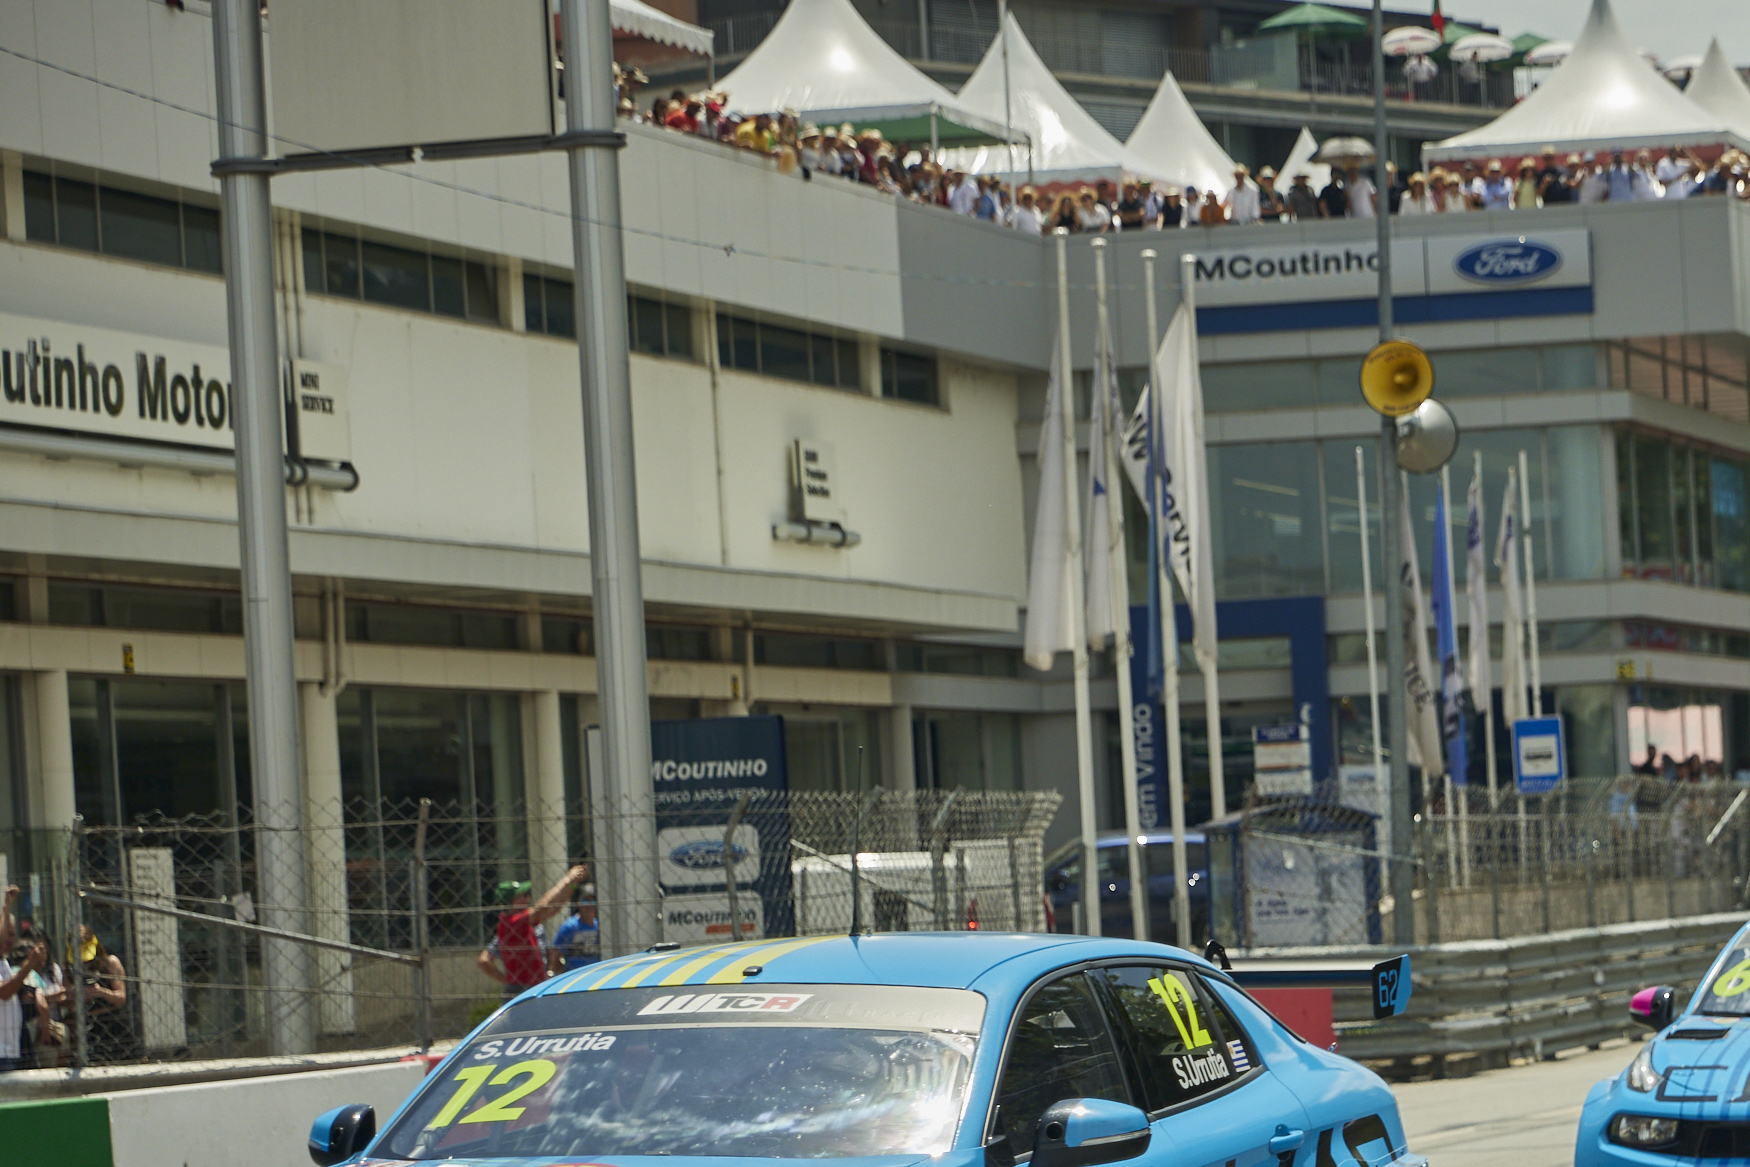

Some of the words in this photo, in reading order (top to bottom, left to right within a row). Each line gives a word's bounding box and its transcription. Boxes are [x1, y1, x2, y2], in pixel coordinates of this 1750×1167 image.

[1195, 249, 1379, 282] MCoutinho
[0, 338, 124, 417] utinho
[1133, 702, 1156, 781] Vindo
[1139, 782, 1158, 829] em
[637, 994, 815, 1016] WTCR
[1378, 969, 1398, 1008] 62
[1147, 974, 1213, 1050] 12
[474, 1032, 617, 1060] S.Urrutia
[1172, 1048, 1230, 1089] S.Urrutia
[429, 1059, 557, 1128] 12
